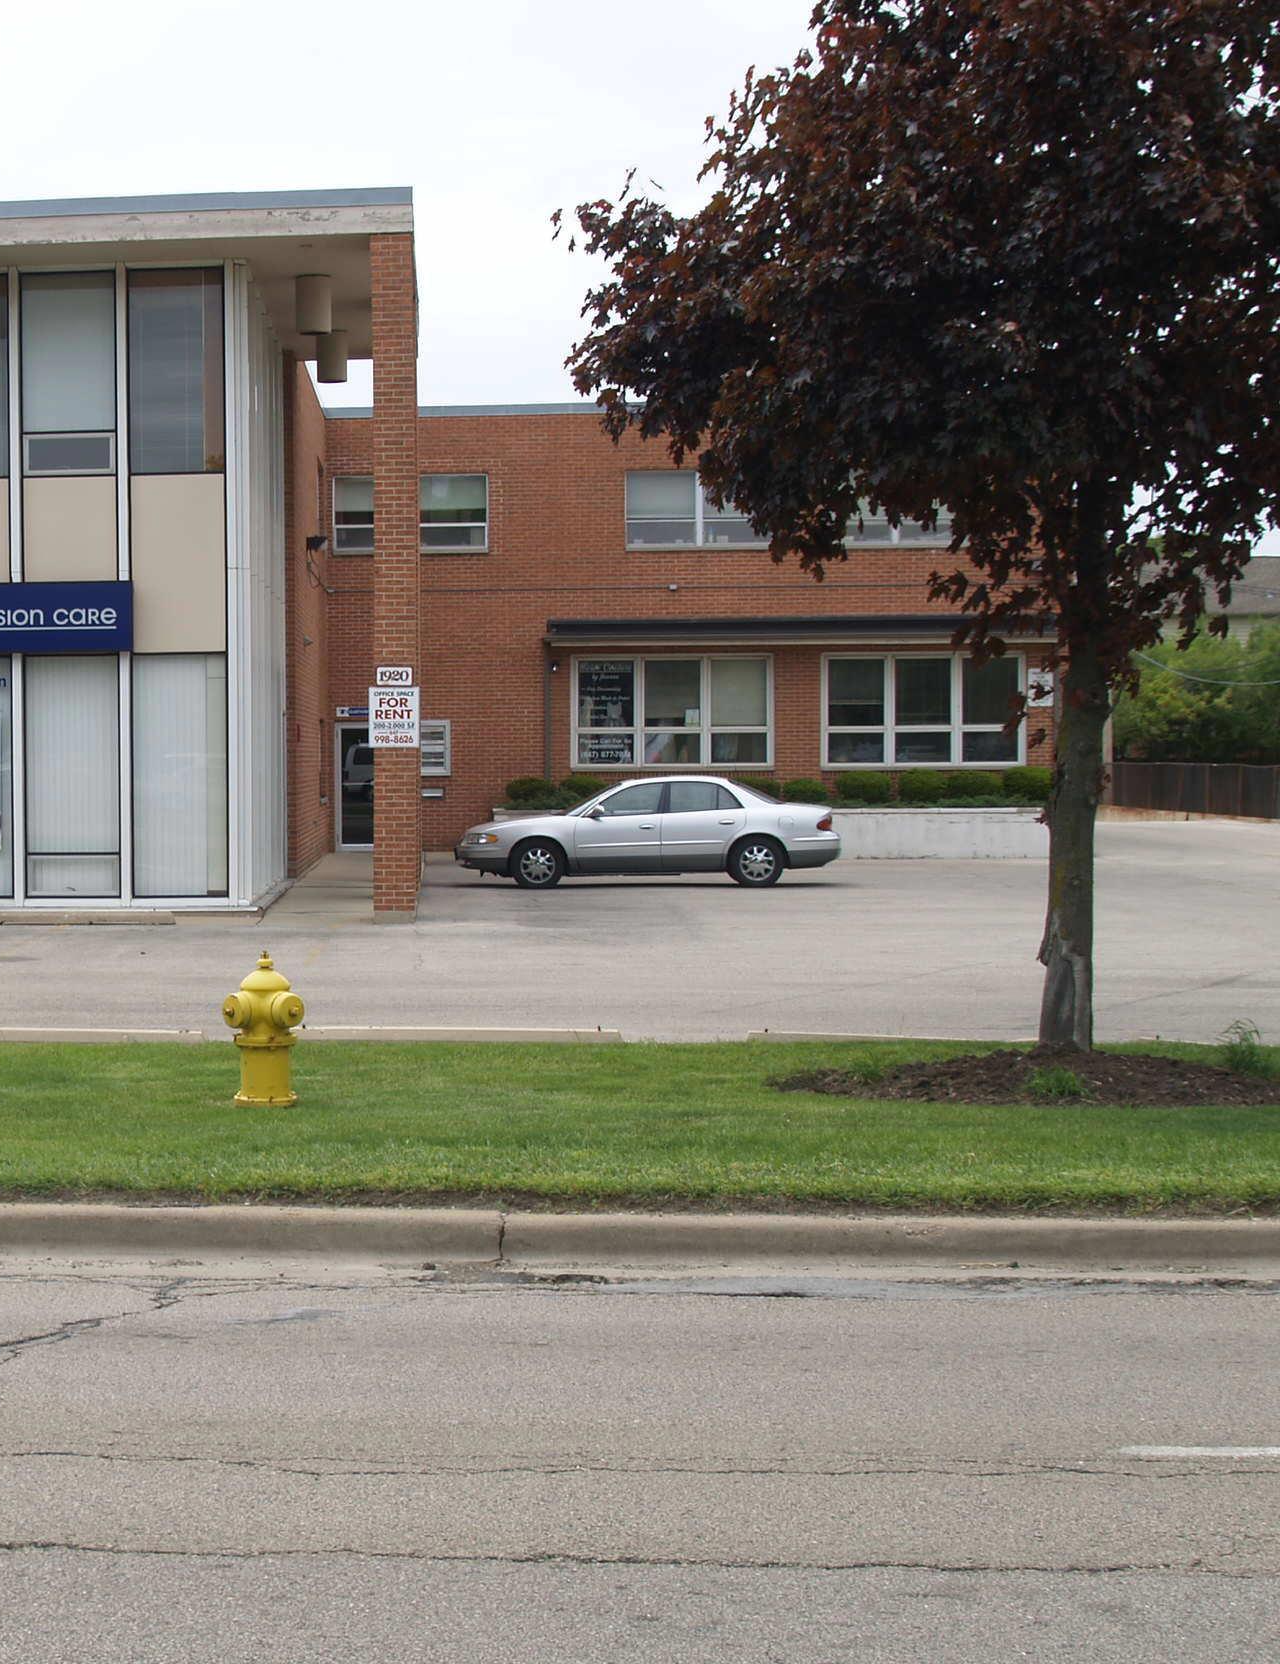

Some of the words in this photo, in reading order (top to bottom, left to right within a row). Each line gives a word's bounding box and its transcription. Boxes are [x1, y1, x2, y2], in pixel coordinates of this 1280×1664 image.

[379, 670, 410, 682] 1920
[379, 697, 408, 708] FOR
[375, 709, 413, 720] RENT
[374, 735, 414, 744] 998-8626
